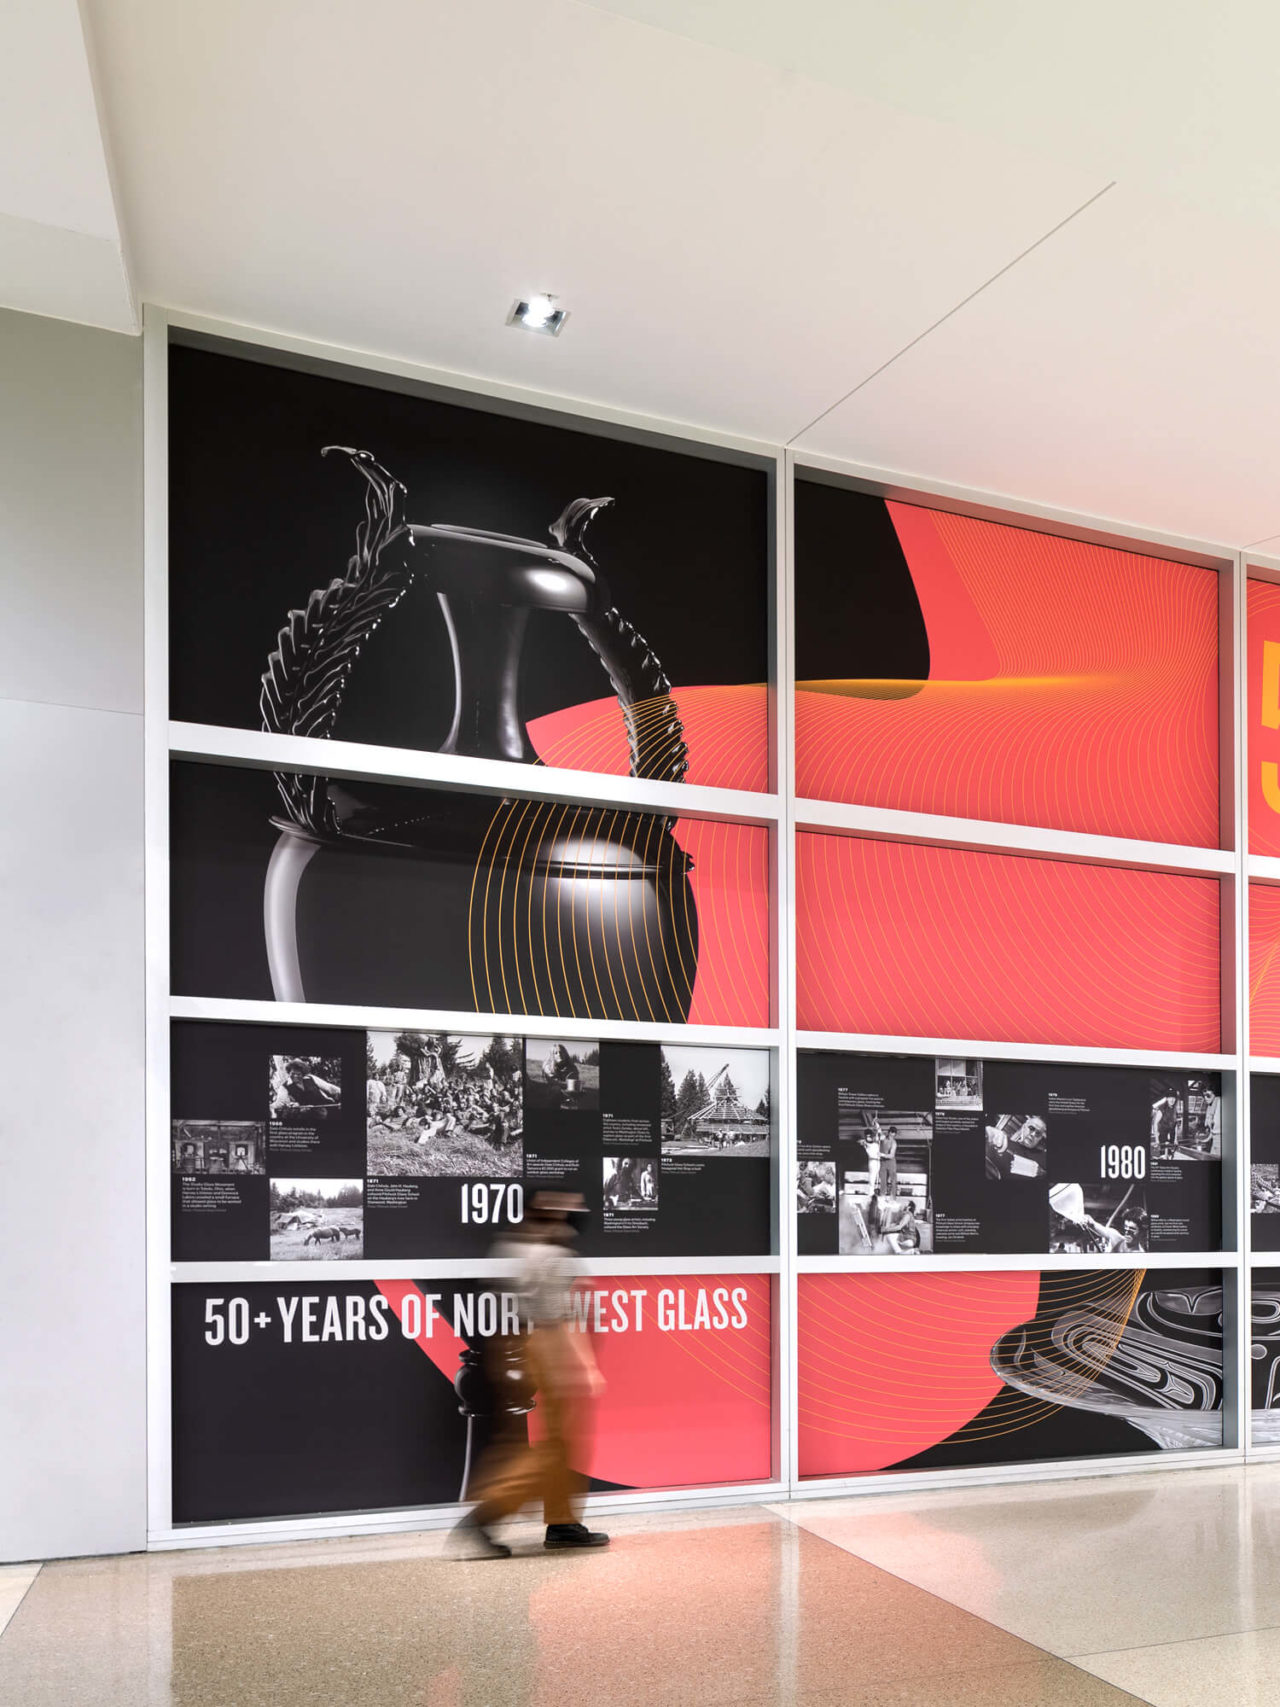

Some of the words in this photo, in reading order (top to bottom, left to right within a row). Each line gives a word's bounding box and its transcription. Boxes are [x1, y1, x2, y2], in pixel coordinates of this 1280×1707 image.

[1100, 1144, 1146, 1179] 1980
[461, 1183, 524, 1224] 1970
[277, 1294, 389, 1343] YEARS
[401, 1293, 442, 1340] OF
[453, 1289, 647, 1337] NORWEST
[657, 1287, 748, 1331] GLASS
